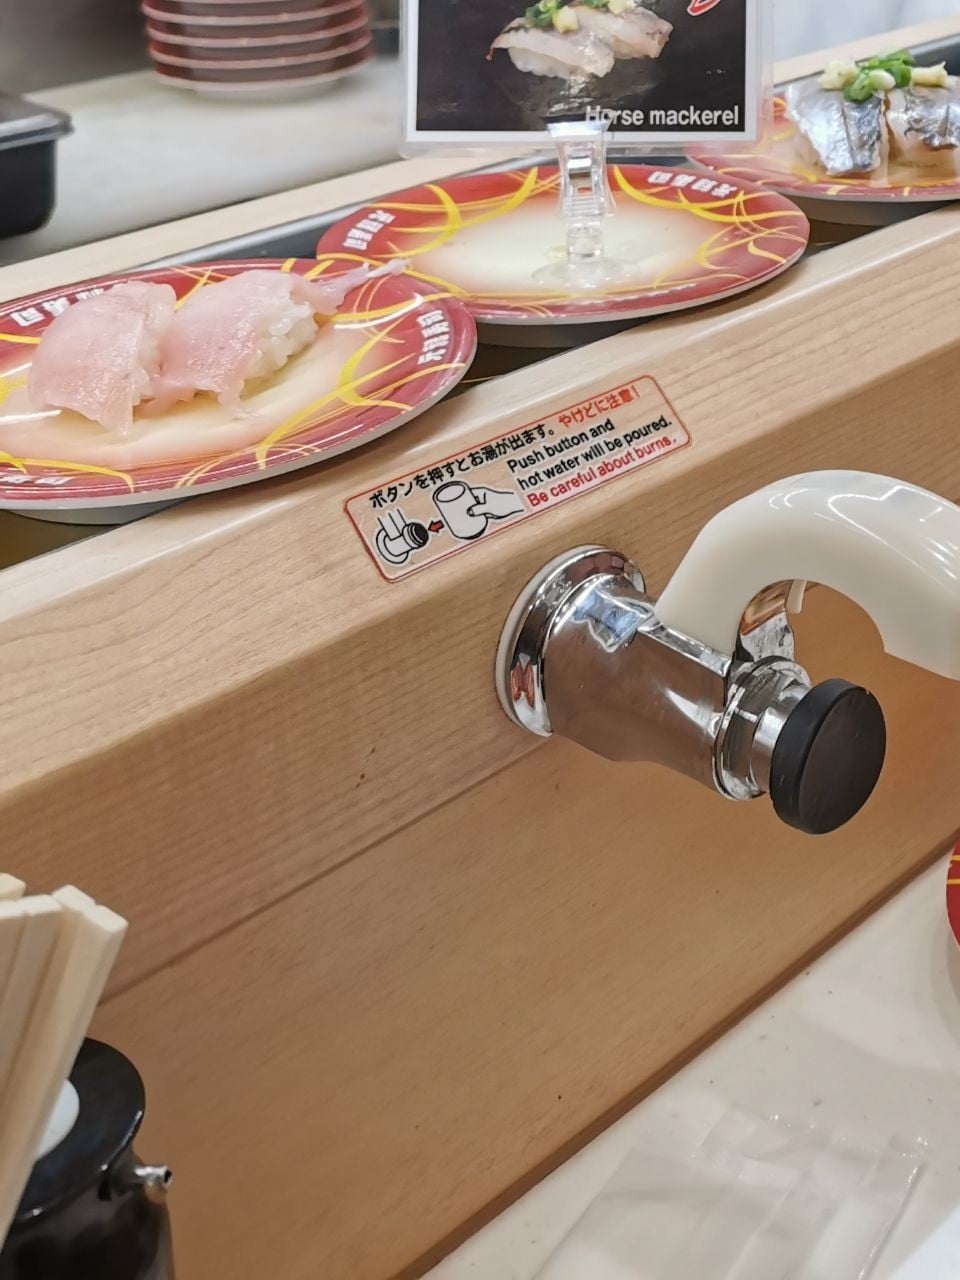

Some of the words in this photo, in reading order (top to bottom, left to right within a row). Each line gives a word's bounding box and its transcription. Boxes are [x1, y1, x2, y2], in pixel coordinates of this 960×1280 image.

[585, 106, 644, 125] Horse
[650, 106, 739, 126] mackerel
[368, 423, 556, 510] ボタンを押すとお湯が出ます。
[507, 449, 545, 474] Push
[548, 431, 590, 458] button
[590, 418, 616, 441] and
[518, 470, 544, 491] hot
[544, 457, 582, 480] water
[581, 443, 606, 463] will
[606, 436, 623, 453] be
[622, 414, 673, 447] poured.
[527, 491, 550, 508] Be
[550, 470, 598, 499] careful
[597, 454, 636, 478] about
[636, 435, 678, 463] burns.
